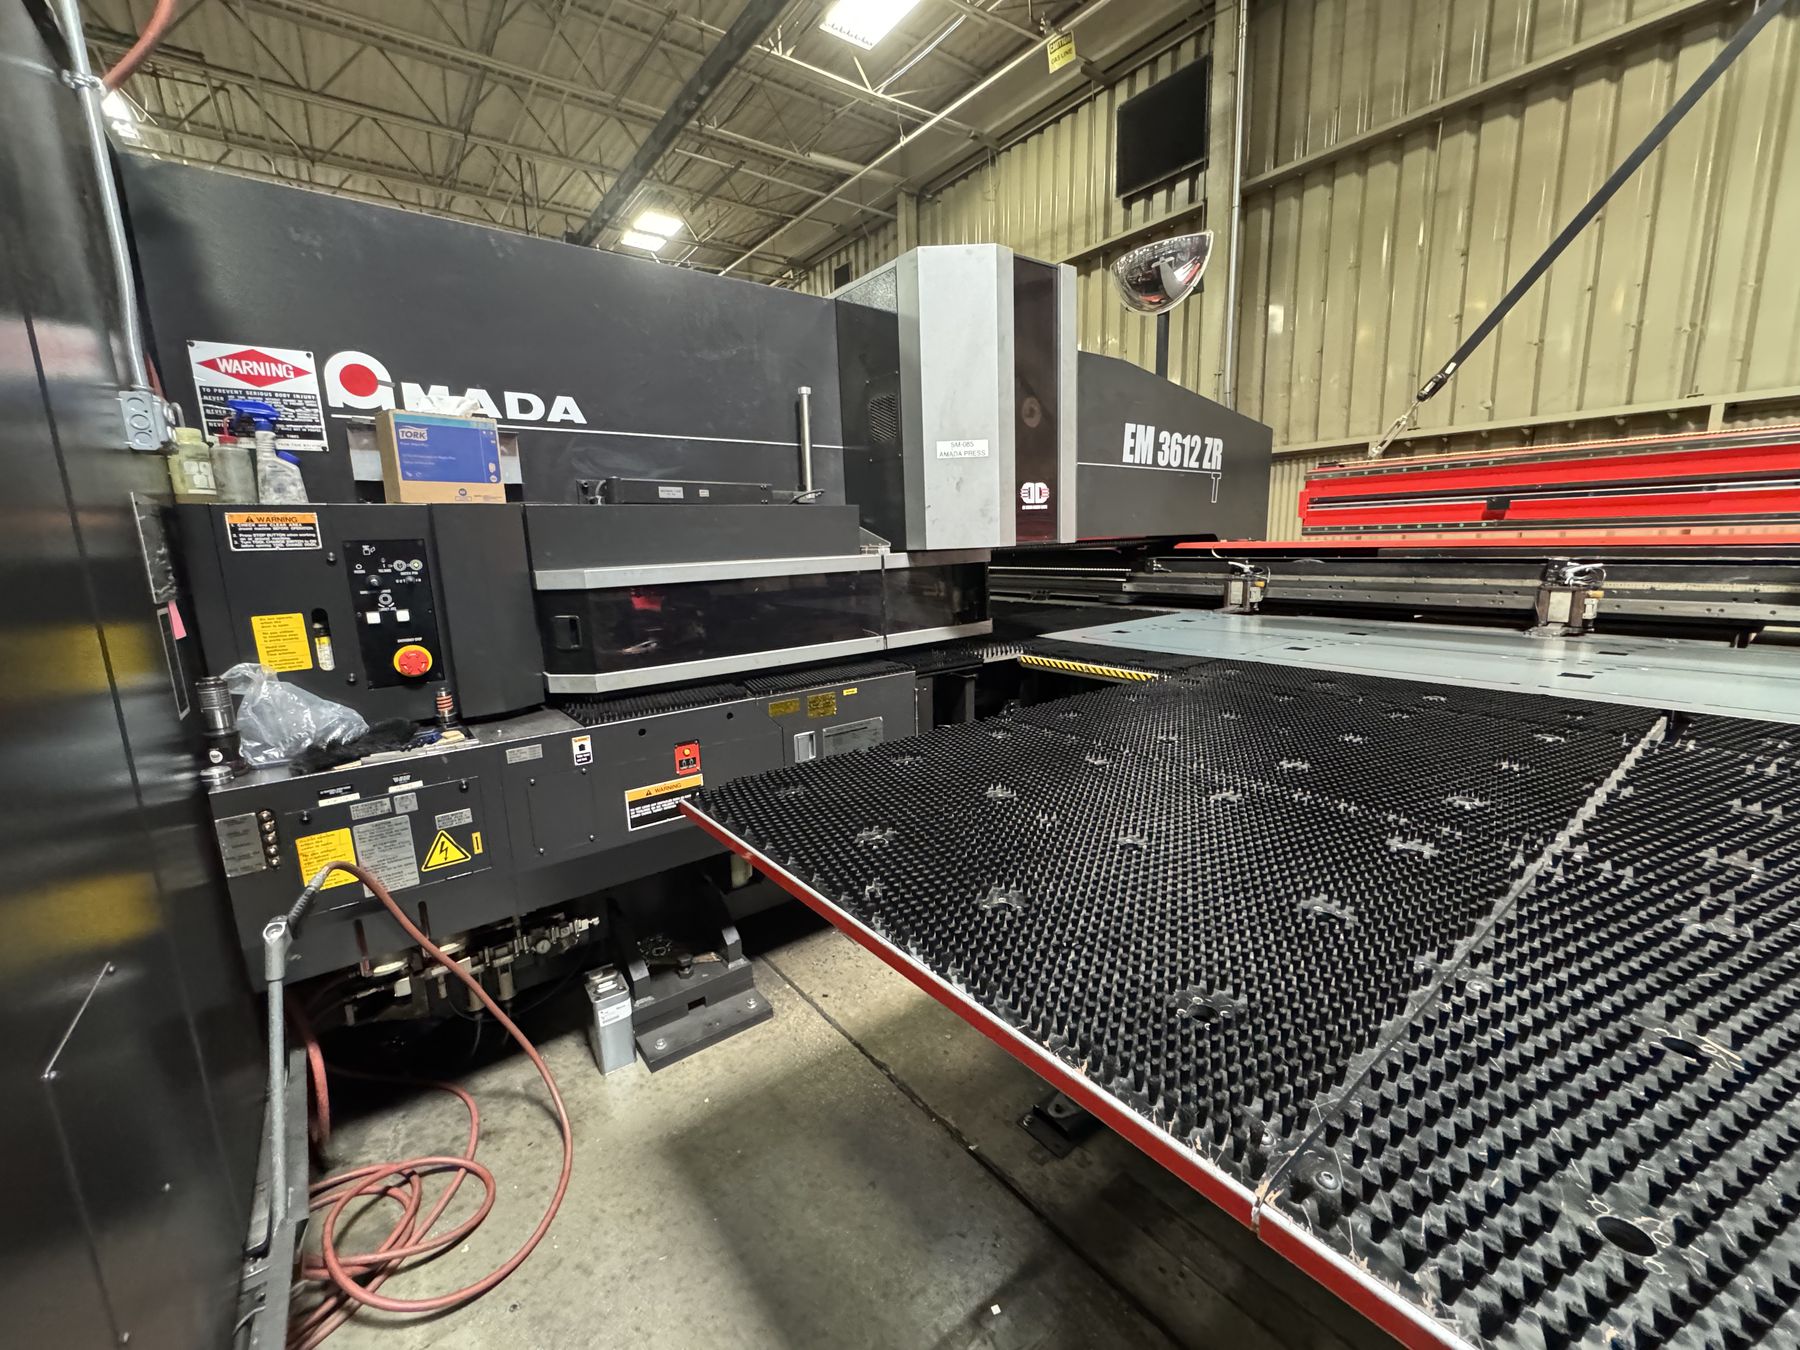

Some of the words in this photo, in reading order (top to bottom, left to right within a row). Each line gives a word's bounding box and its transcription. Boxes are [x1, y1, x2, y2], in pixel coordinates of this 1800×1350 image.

[1051, 54, 1061, 65] GAS
[215, 357, 295, 379] WARNING
[400, 430, 427, 440] TORK
[1122, 422, 1155, 465] EM
[1157, 430, 1202, 468] 3612
[1202, 436, 1224, 470] ZR
[654, 782, 682, 794] WARNING
